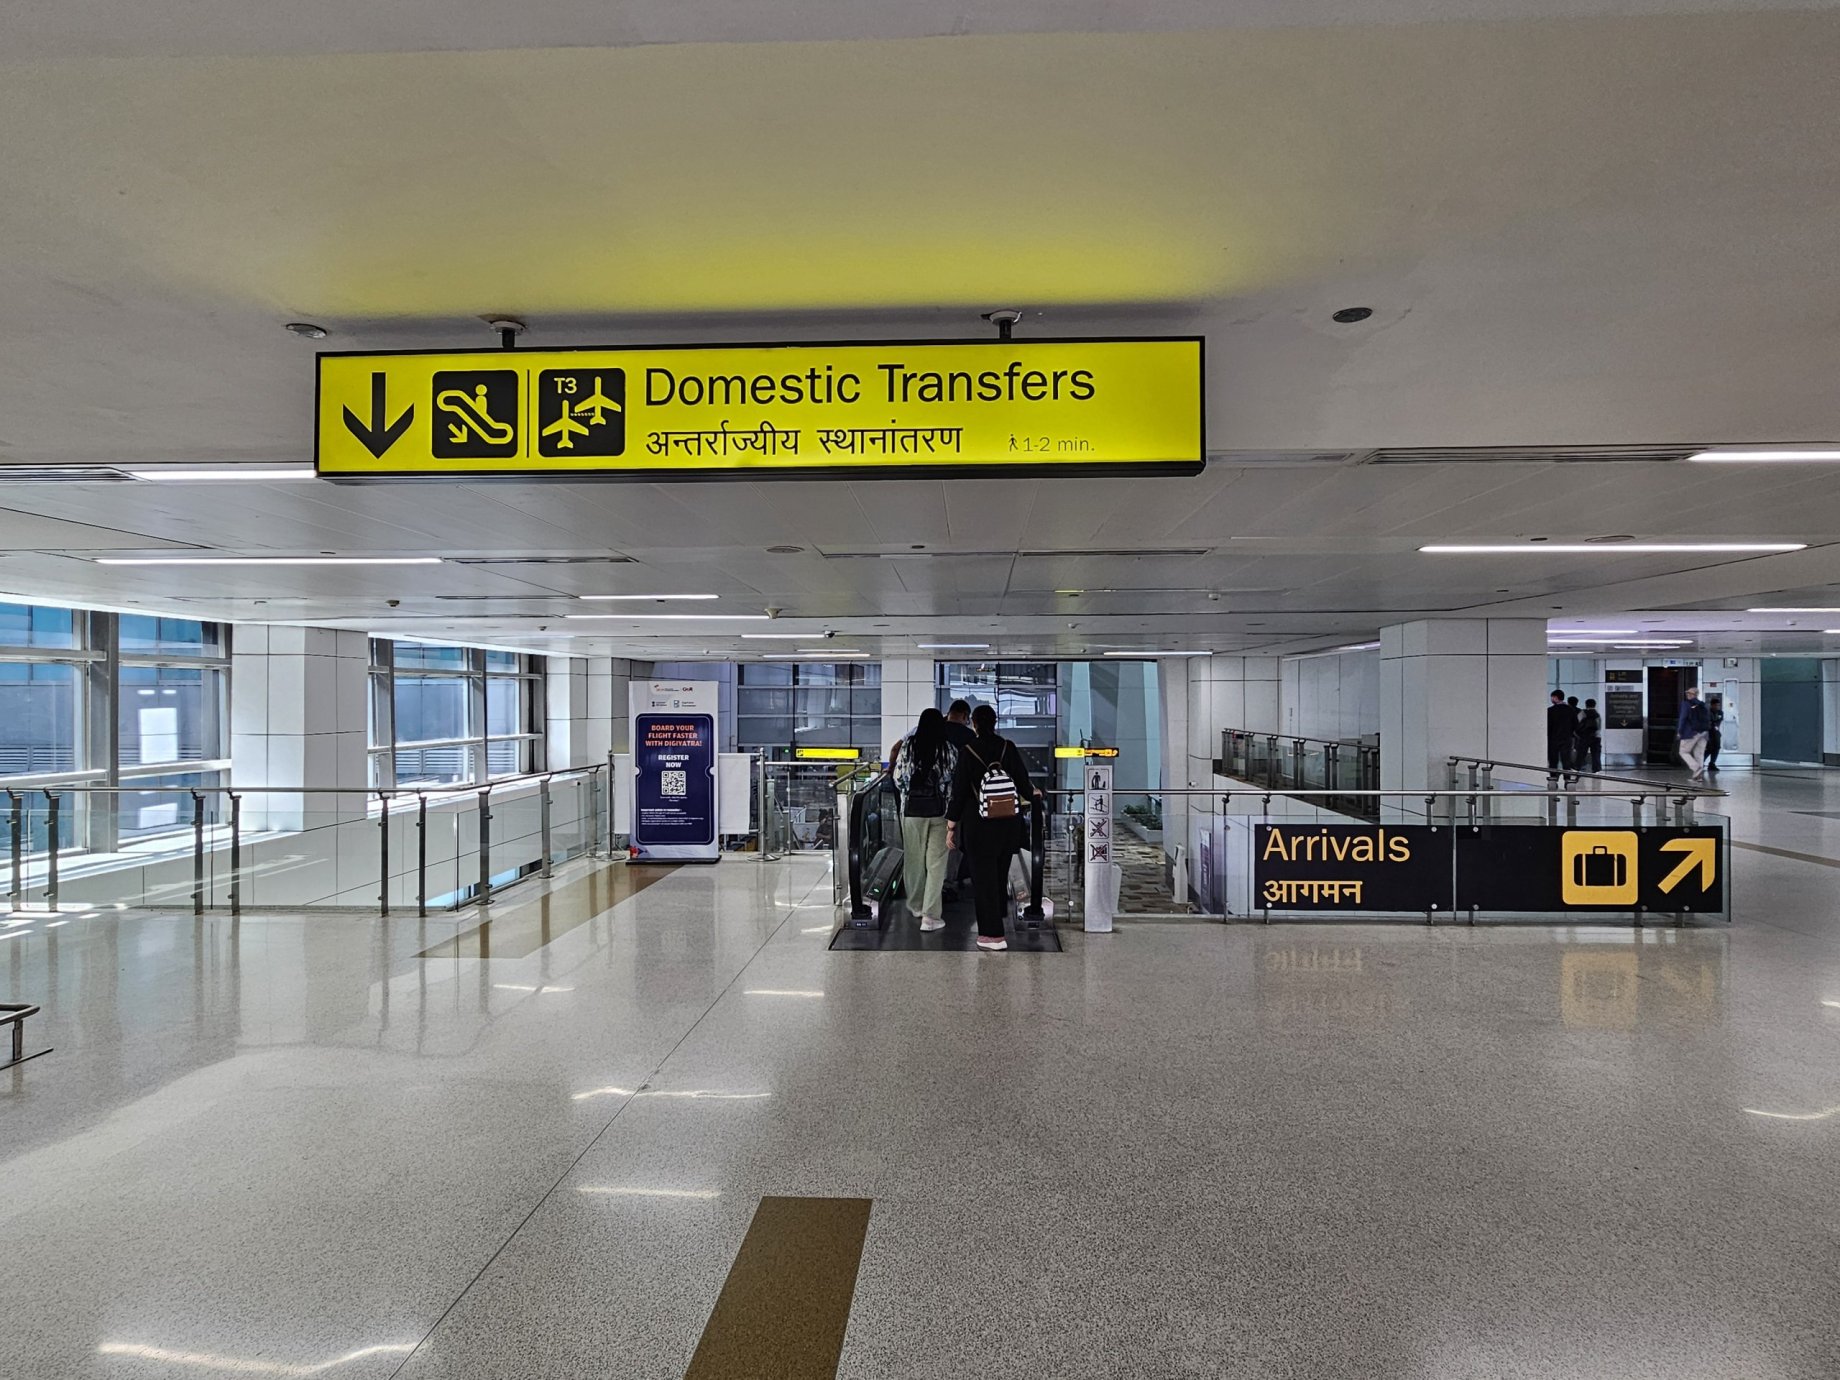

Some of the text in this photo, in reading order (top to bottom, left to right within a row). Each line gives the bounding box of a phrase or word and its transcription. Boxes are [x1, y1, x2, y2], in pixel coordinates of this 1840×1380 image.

[553, 377, 578, 394] T3
[645, 361, 1096, 406] Domestic Transfers
[645, 419, 963, 456] अन्तर्राज्यीय स्थानांतरण
[1022, 436, 1096, 452] 1-2 min.
[1262, 828, 1411, 863] Arrivals
[1263, 880, 1364, 904] आगमन
